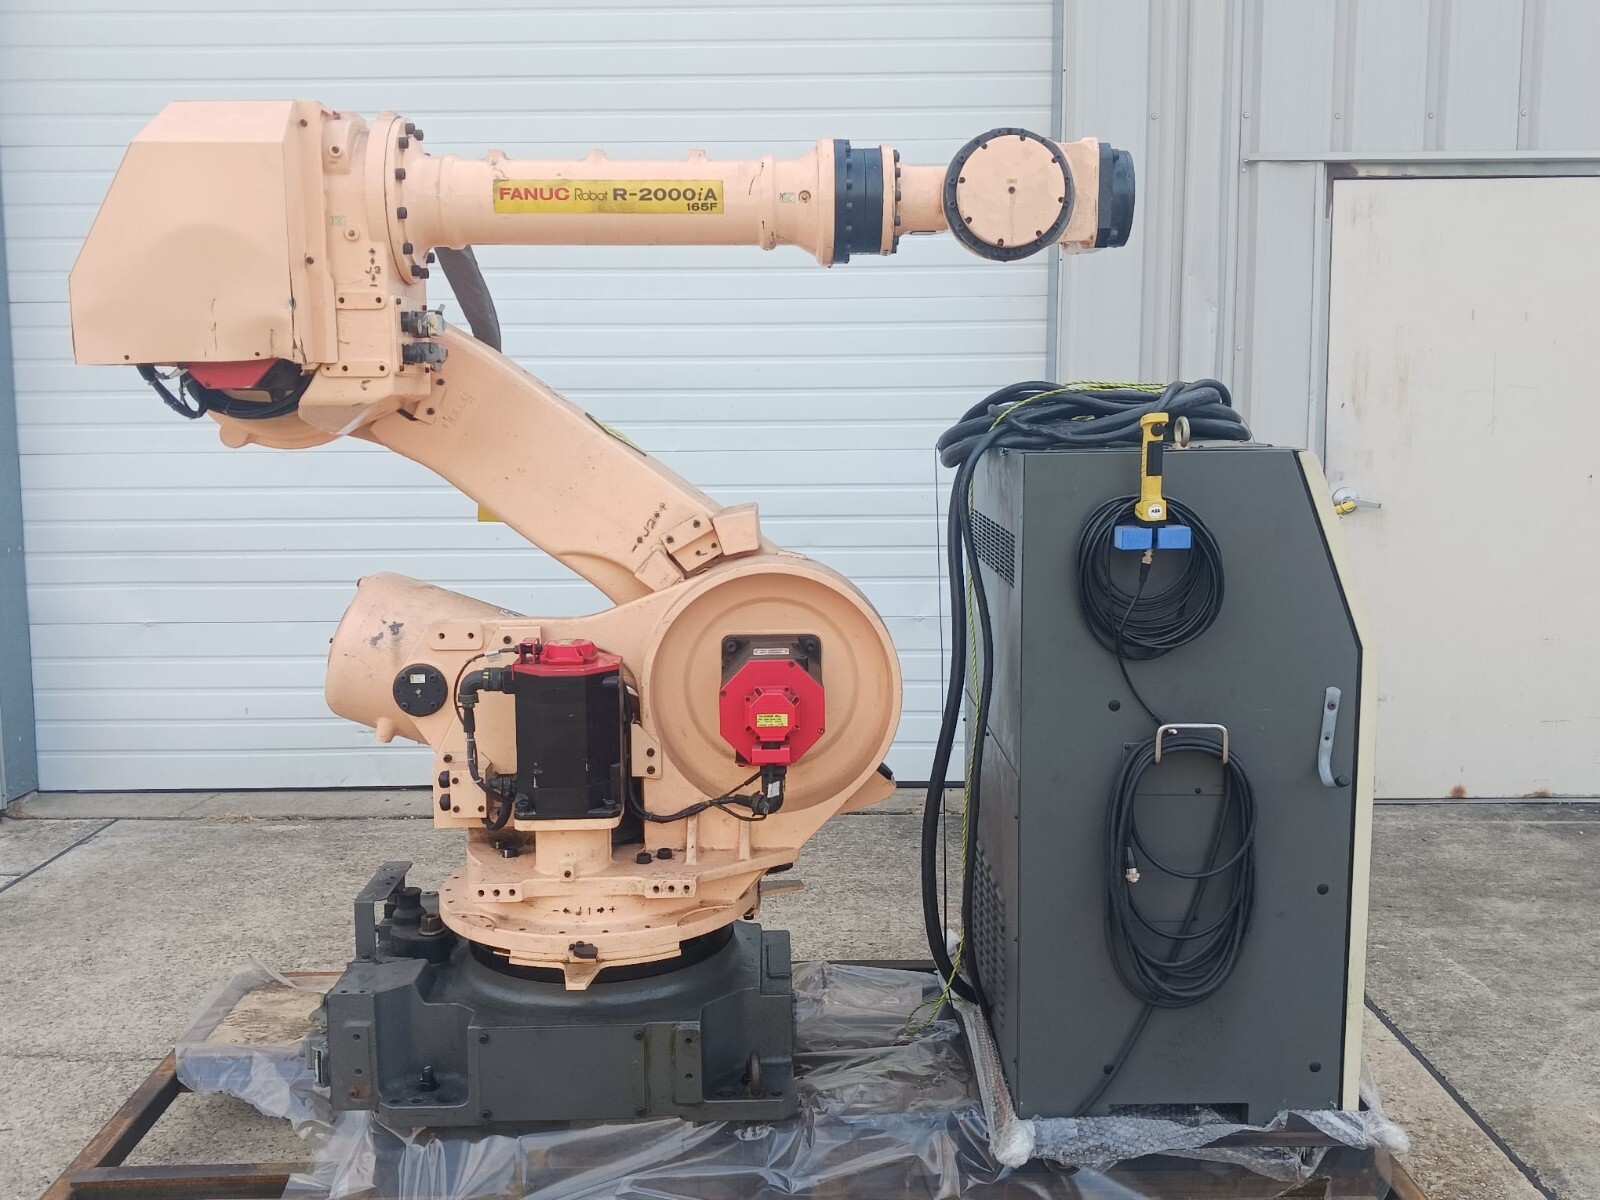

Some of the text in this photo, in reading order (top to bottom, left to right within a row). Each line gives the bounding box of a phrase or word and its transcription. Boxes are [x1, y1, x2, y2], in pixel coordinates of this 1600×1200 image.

[499, 187, 718, 201] FANUC Robot R-2000iA
[686, 202, 718, 212] 165F
